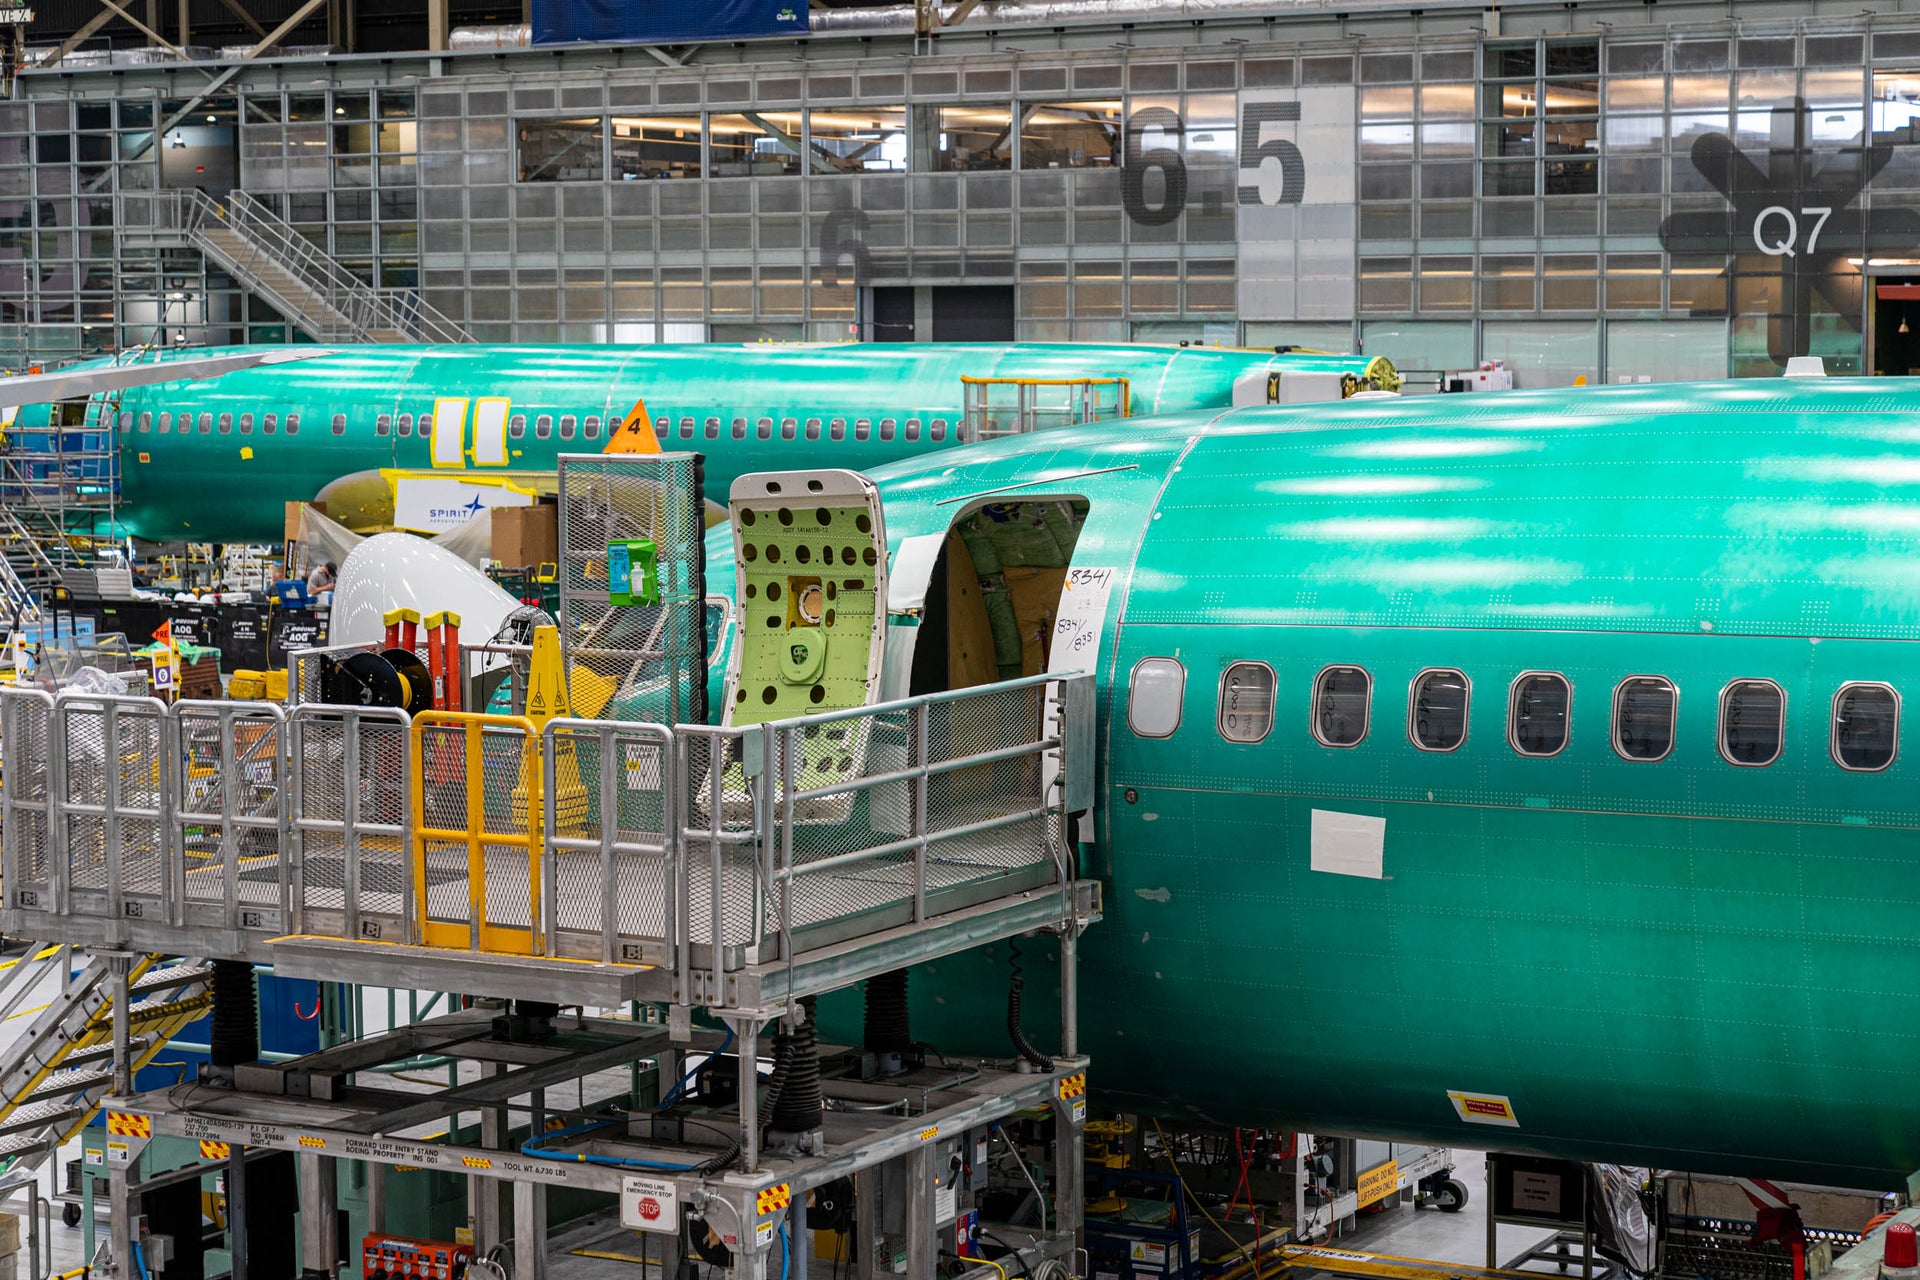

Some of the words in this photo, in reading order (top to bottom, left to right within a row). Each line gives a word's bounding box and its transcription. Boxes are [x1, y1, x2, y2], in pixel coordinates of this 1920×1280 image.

[1753, 205, 1832, 258] Q7
[627, 417, 641, 435] 4
[429, 509, 469, 518] SPIRIT
[155, 630, 169, 639] PRE
[174, 625, 192, 634] AOG
[288, 632, 309, 642] AOG
[160, 671, 167, 681] 6
[115, 1120, 125, 1128] FOD
[125, 1121, 145, 1130] CRITICAL
[345, 1139, 378, 1149] FORWARD
[379, 1143, 393, 1151] LEFT
[395, 1145, 415, 1154] ENTRY
[417, 1148, 439, 1157] STAND
[345, 1146, 370, 1155] BOEING
[373, 1150, 405, 1160] PROPERTY
[504, 1162, 522, 1172] TOOL
[523, 1165, 533, 1173] WT
[555, 1169, 567, 1177] LBS
[1359, 1173, 1380, 1189] WARNING
[1380, 1169, 1387, 1181] DO
[633, 1181, 653, 1189] MOVING
[1383, 1179, 1394, 1192] ONLY
[626, 1187, 657, 1197] EMERGENCY
[640, 1202, 659, 1215] STOP
